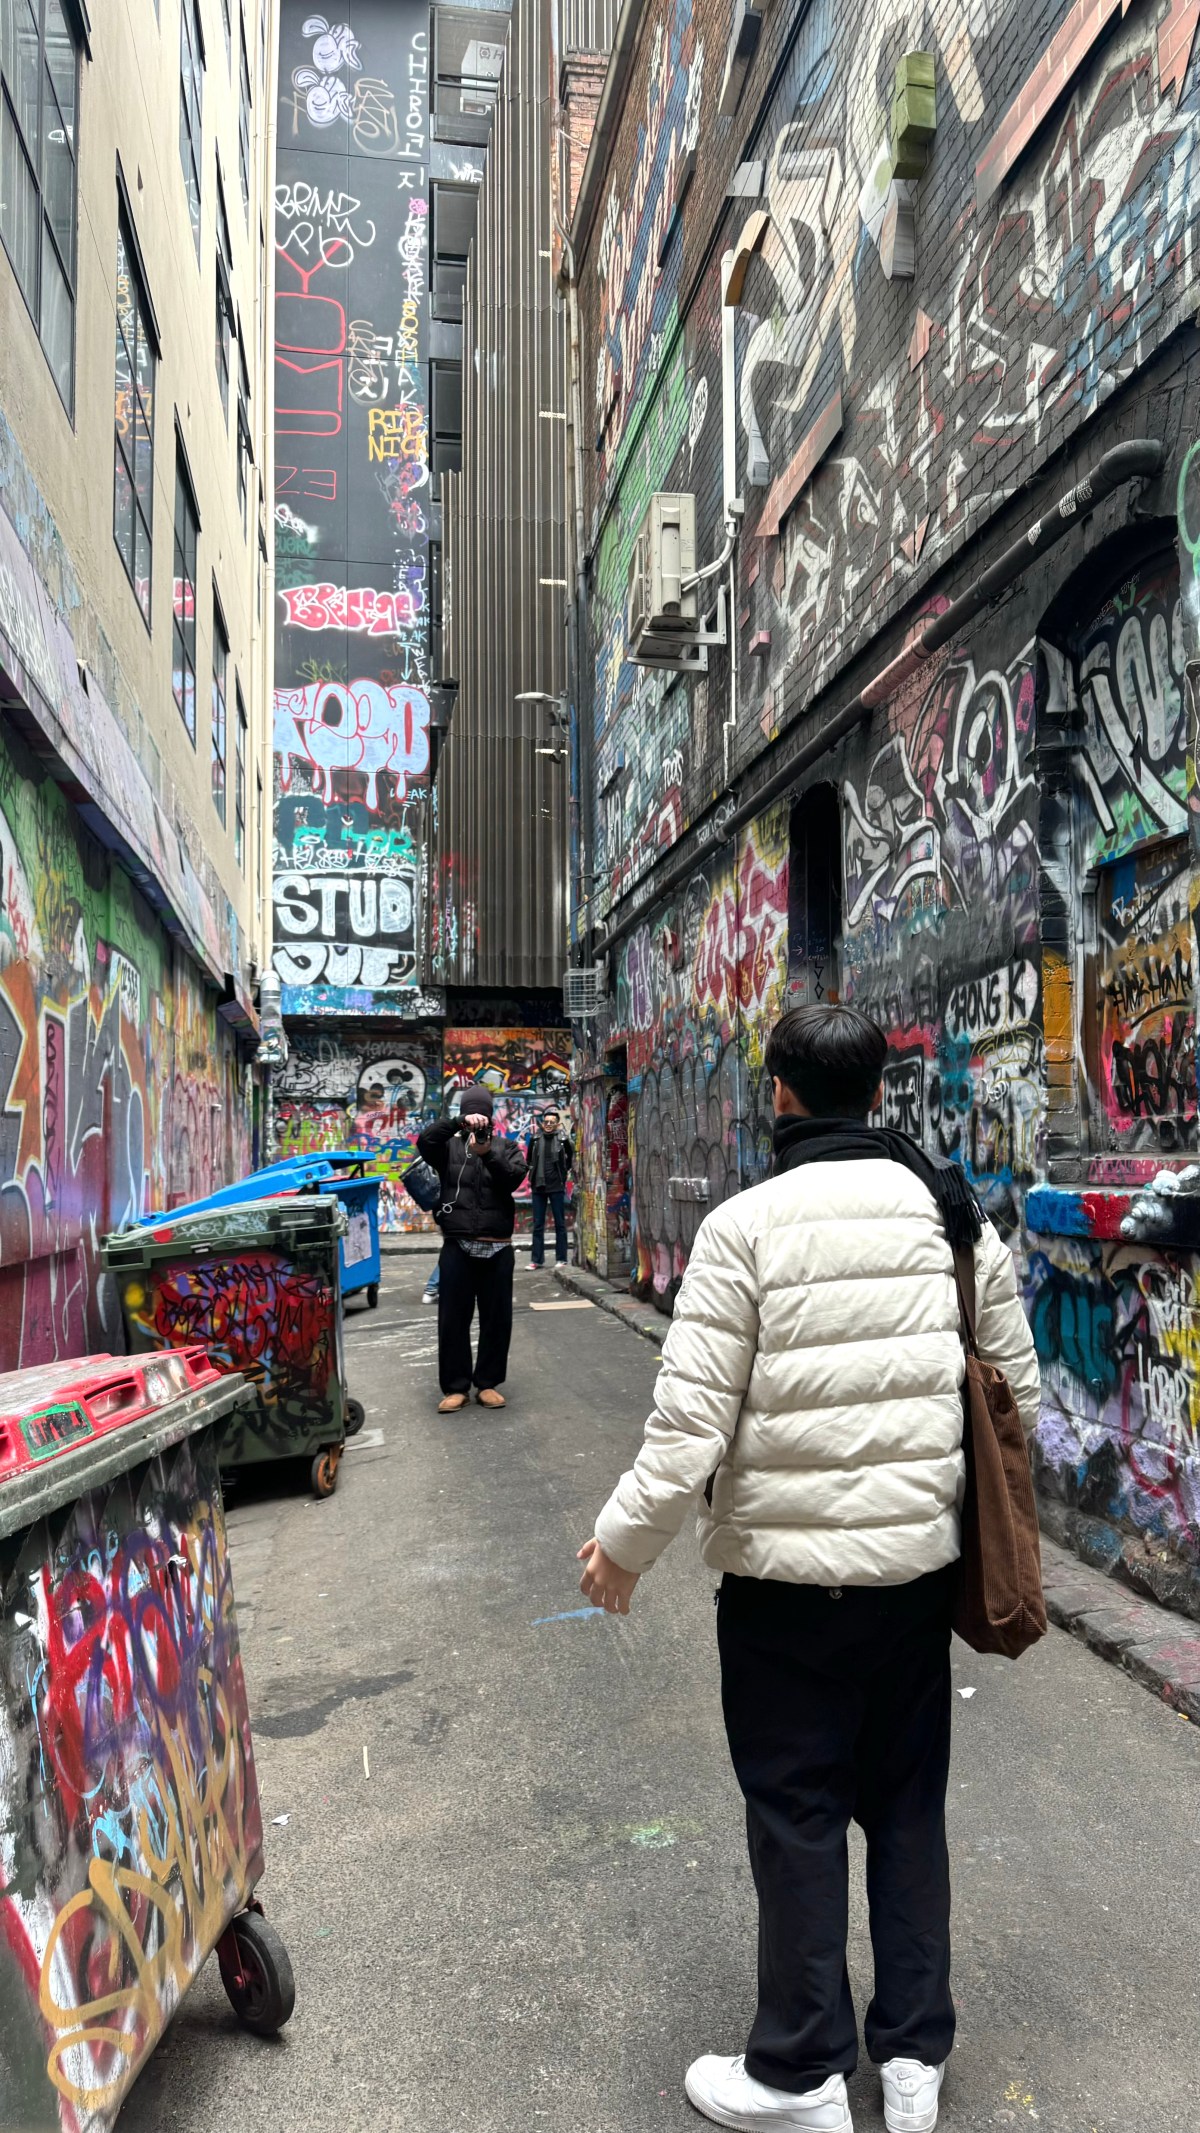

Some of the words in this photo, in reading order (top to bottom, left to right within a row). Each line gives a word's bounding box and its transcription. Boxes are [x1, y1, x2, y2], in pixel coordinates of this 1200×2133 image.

[368, 408, 423, 436] RIP
[368, 431, 429, 462] NICK
[272, 874, 412, 937] STUD
